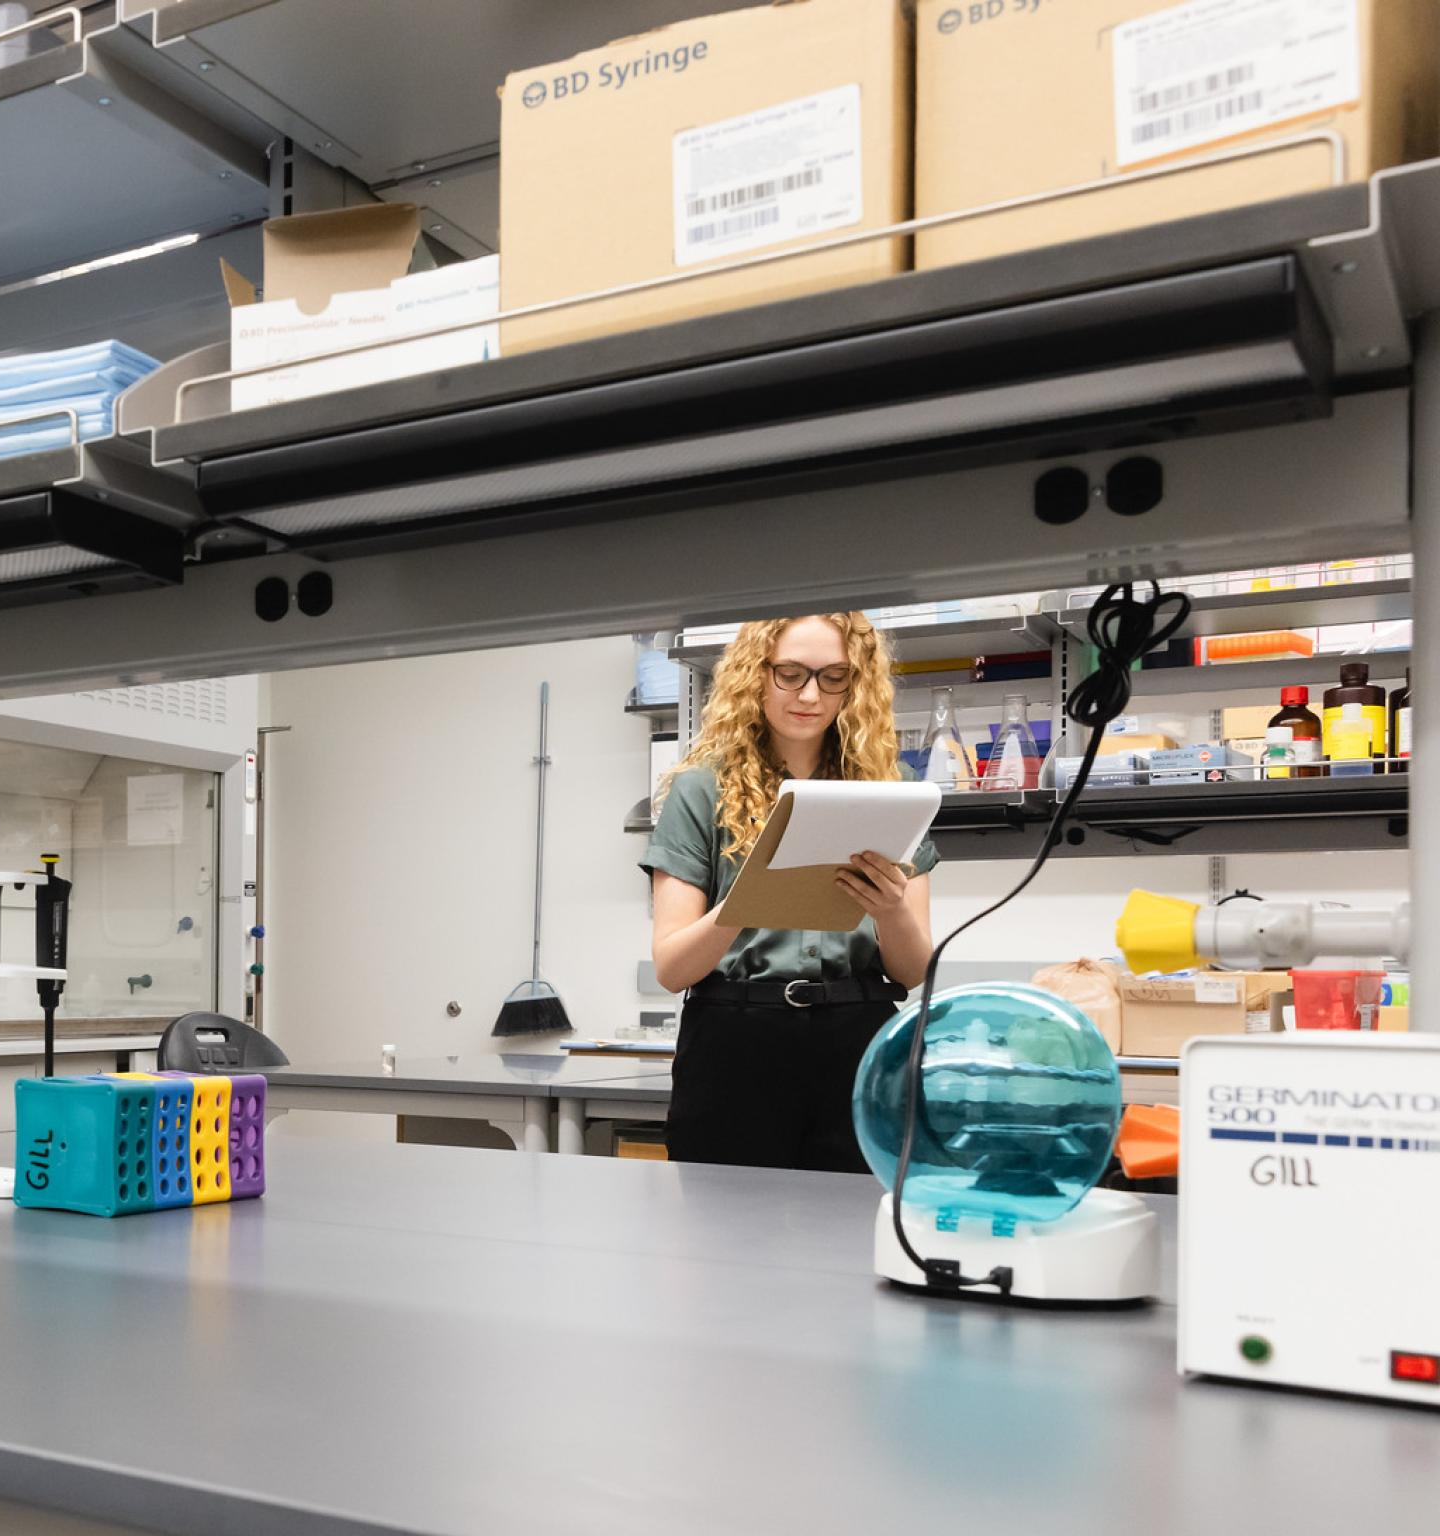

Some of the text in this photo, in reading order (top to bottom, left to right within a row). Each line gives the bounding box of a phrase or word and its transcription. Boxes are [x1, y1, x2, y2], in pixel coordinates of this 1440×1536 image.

[969, 0, 1005, 25] BD
[553, 40, 709, 99] BD Syringe
[1208, 1084, 1440, 1114] GERMINATO
[1207, 1106, 1276, 1125] 500
[25, 1129, 53, 1191] GILL
[1250, 1153, 1318, 1187] GILL
